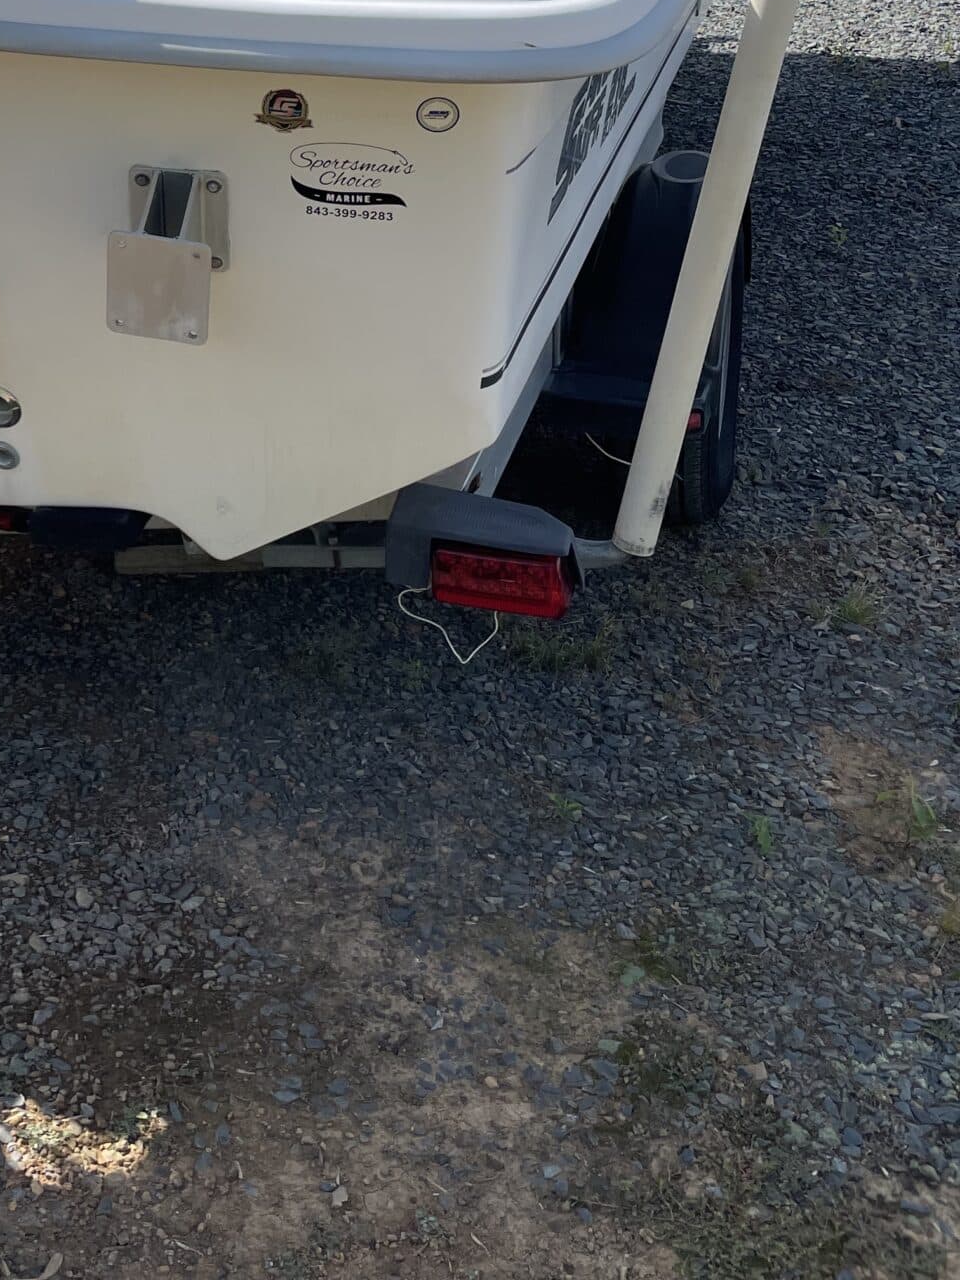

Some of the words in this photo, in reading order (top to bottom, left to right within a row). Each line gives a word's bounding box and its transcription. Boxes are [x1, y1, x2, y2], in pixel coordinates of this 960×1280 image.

[299, 150, 415, 175] Sportsman's
[318, 170, 382, 188] Choice
[325, 192, 372, 204] MARINE
[305, 205, 394, 221] 843-399-9283
